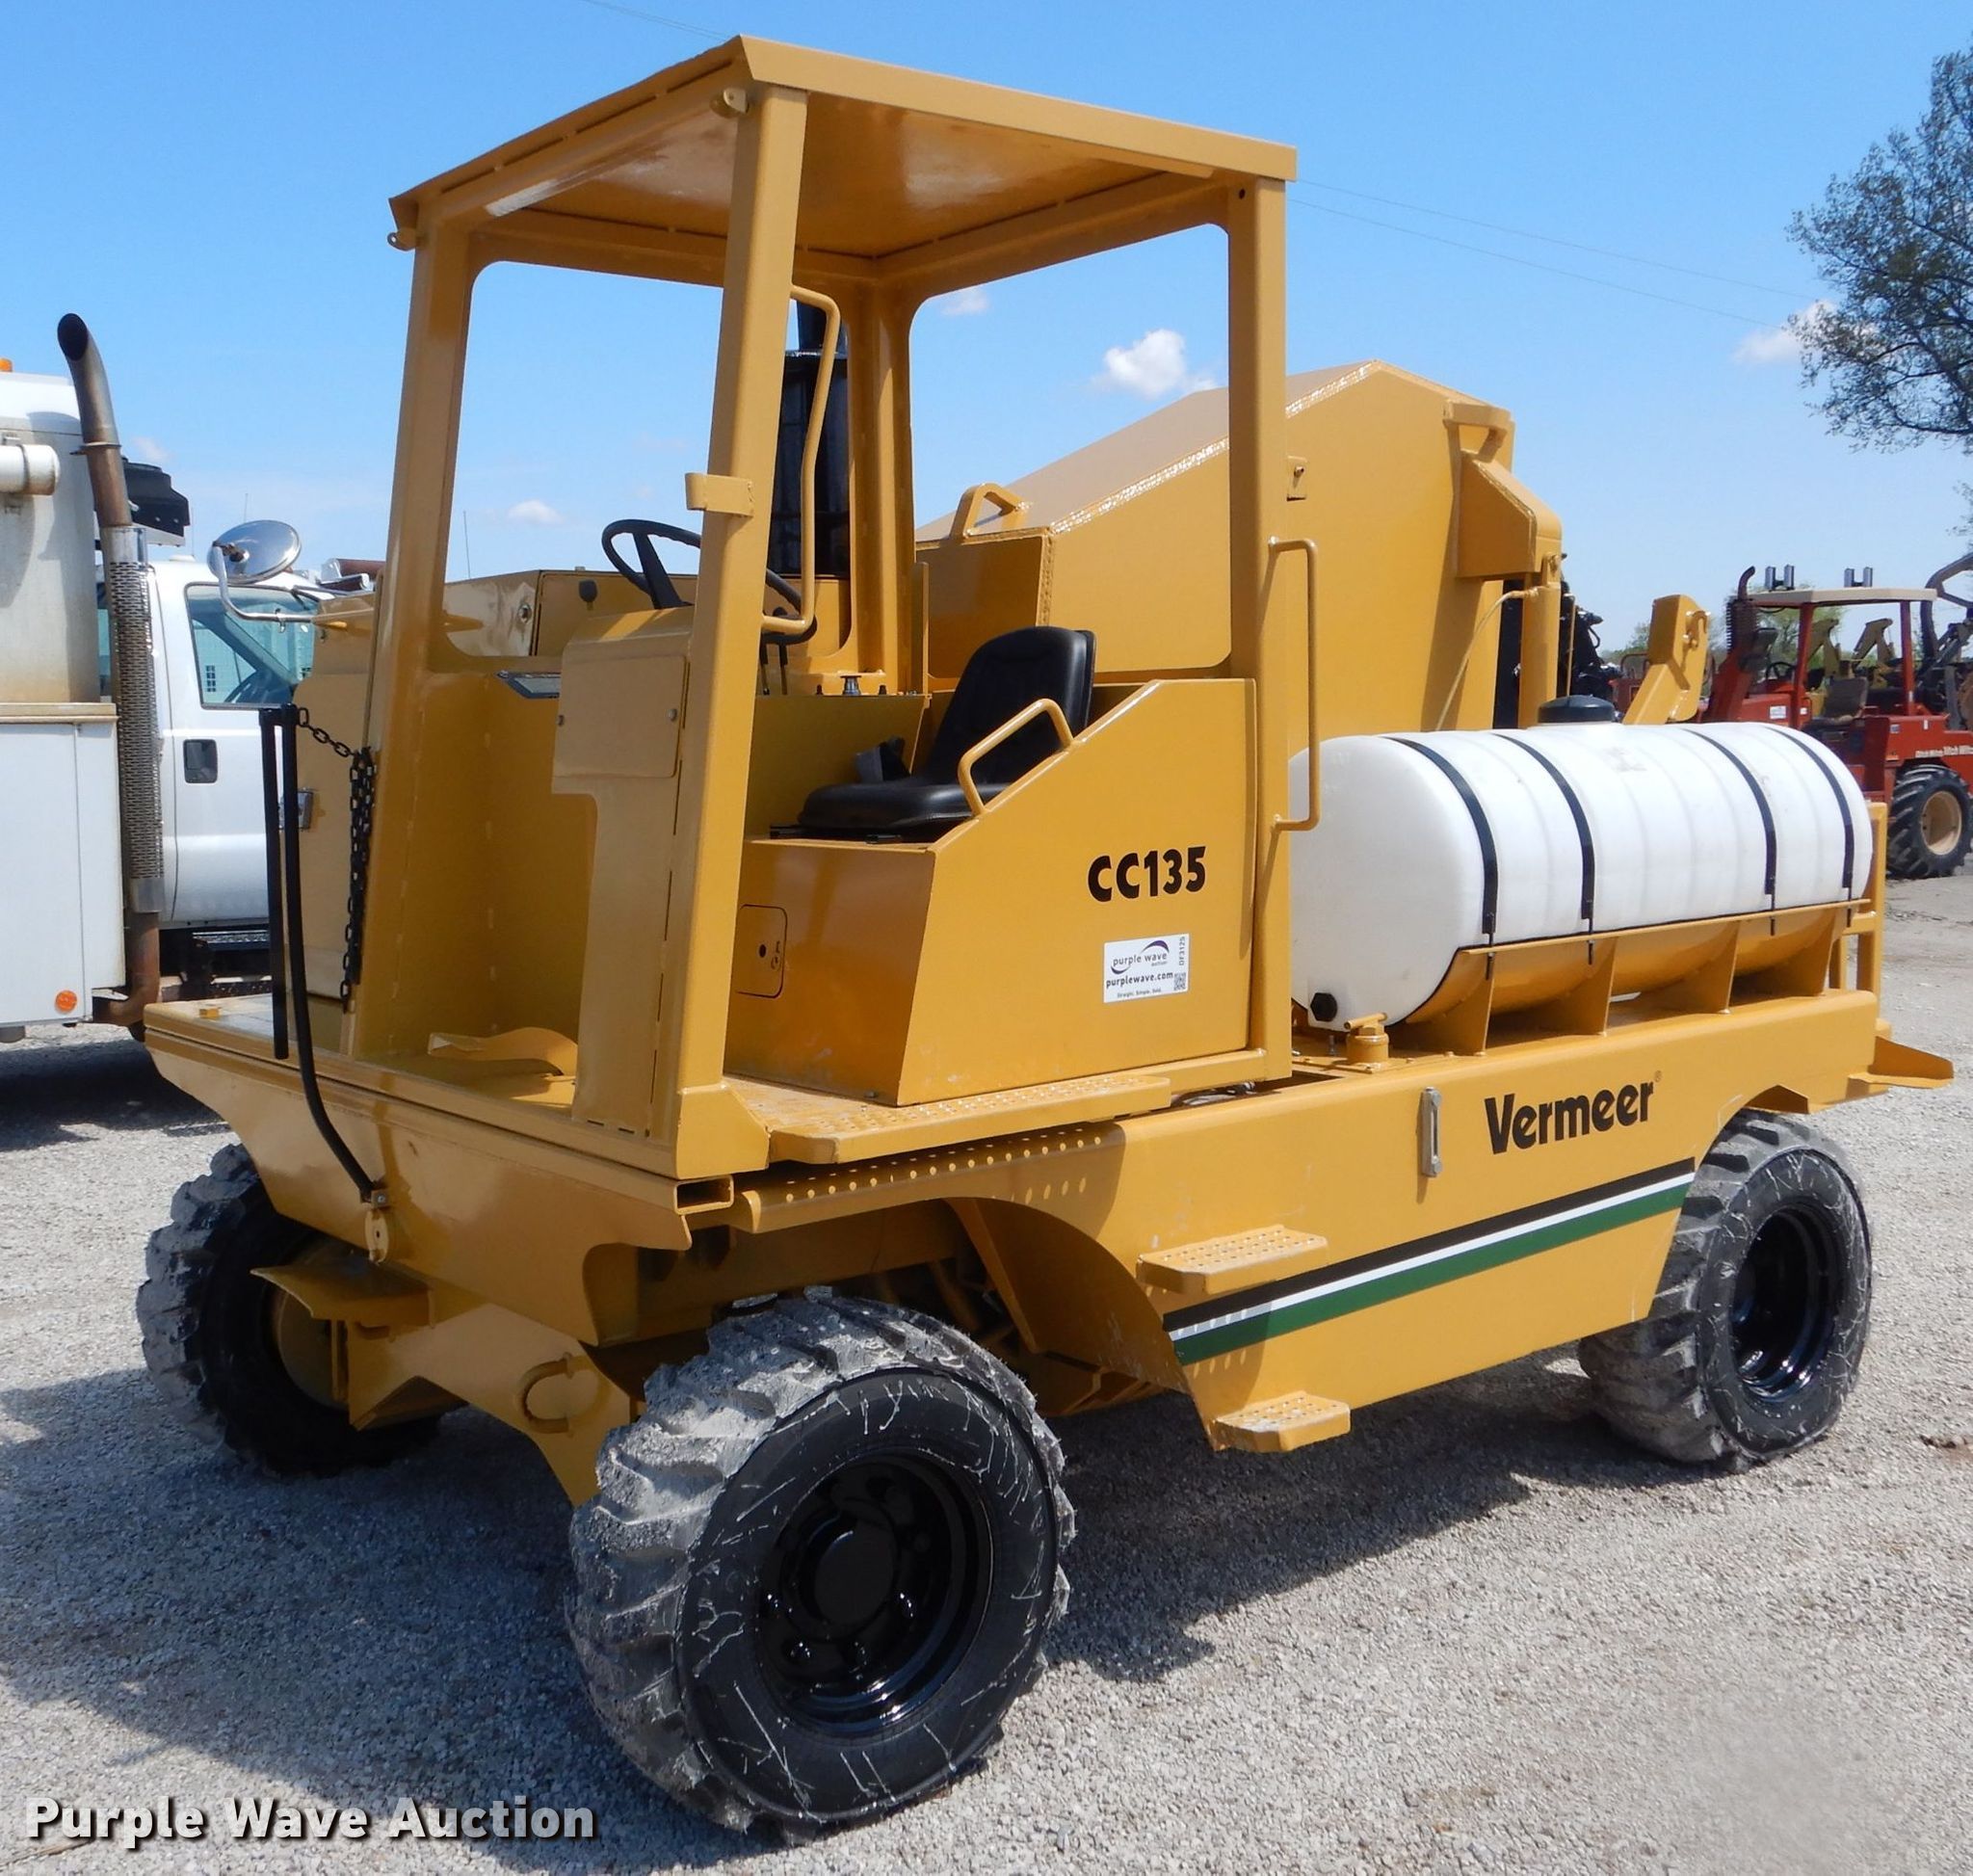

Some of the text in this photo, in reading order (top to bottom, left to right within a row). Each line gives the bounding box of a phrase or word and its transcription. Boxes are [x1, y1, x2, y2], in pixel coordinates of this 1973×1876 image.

[1088, 846, 1206, 902] CC135
[1113, 954, 1142, 966] purple
[1144, 953, 1168, 962] wave
[1106, 971, 1173, 989] purplewave.com
[1484, 1081, 1654, 1154] Vermeer
